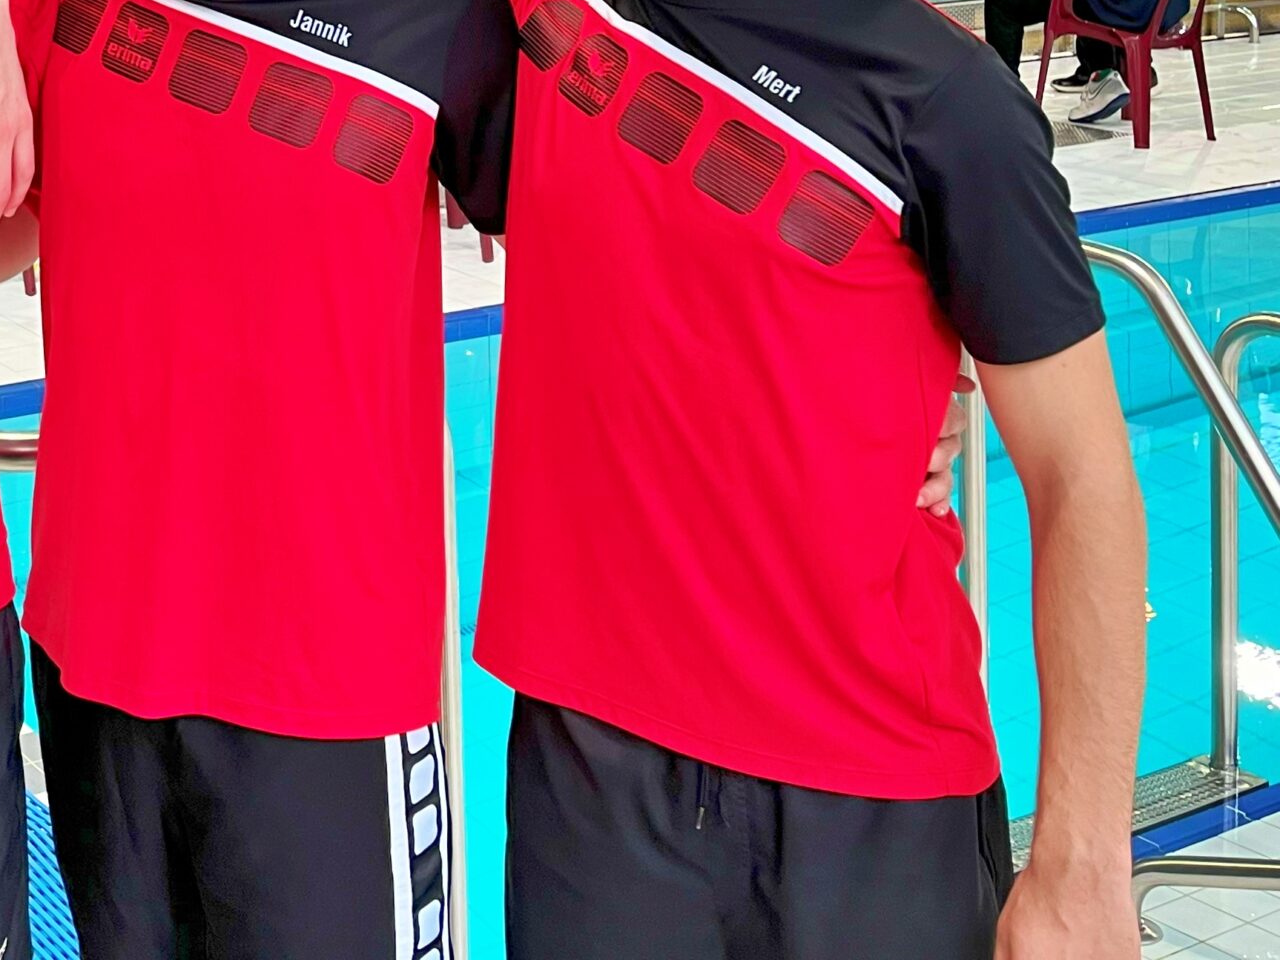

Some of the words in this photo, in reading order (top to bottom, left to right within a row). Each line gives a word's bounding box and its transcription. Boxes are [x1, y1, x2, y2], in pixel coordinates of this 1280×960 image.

[288, 9, 353, 48] Jannik
[107, 42, 153, 72] erima
[751, 64, 802, 104] Mert
